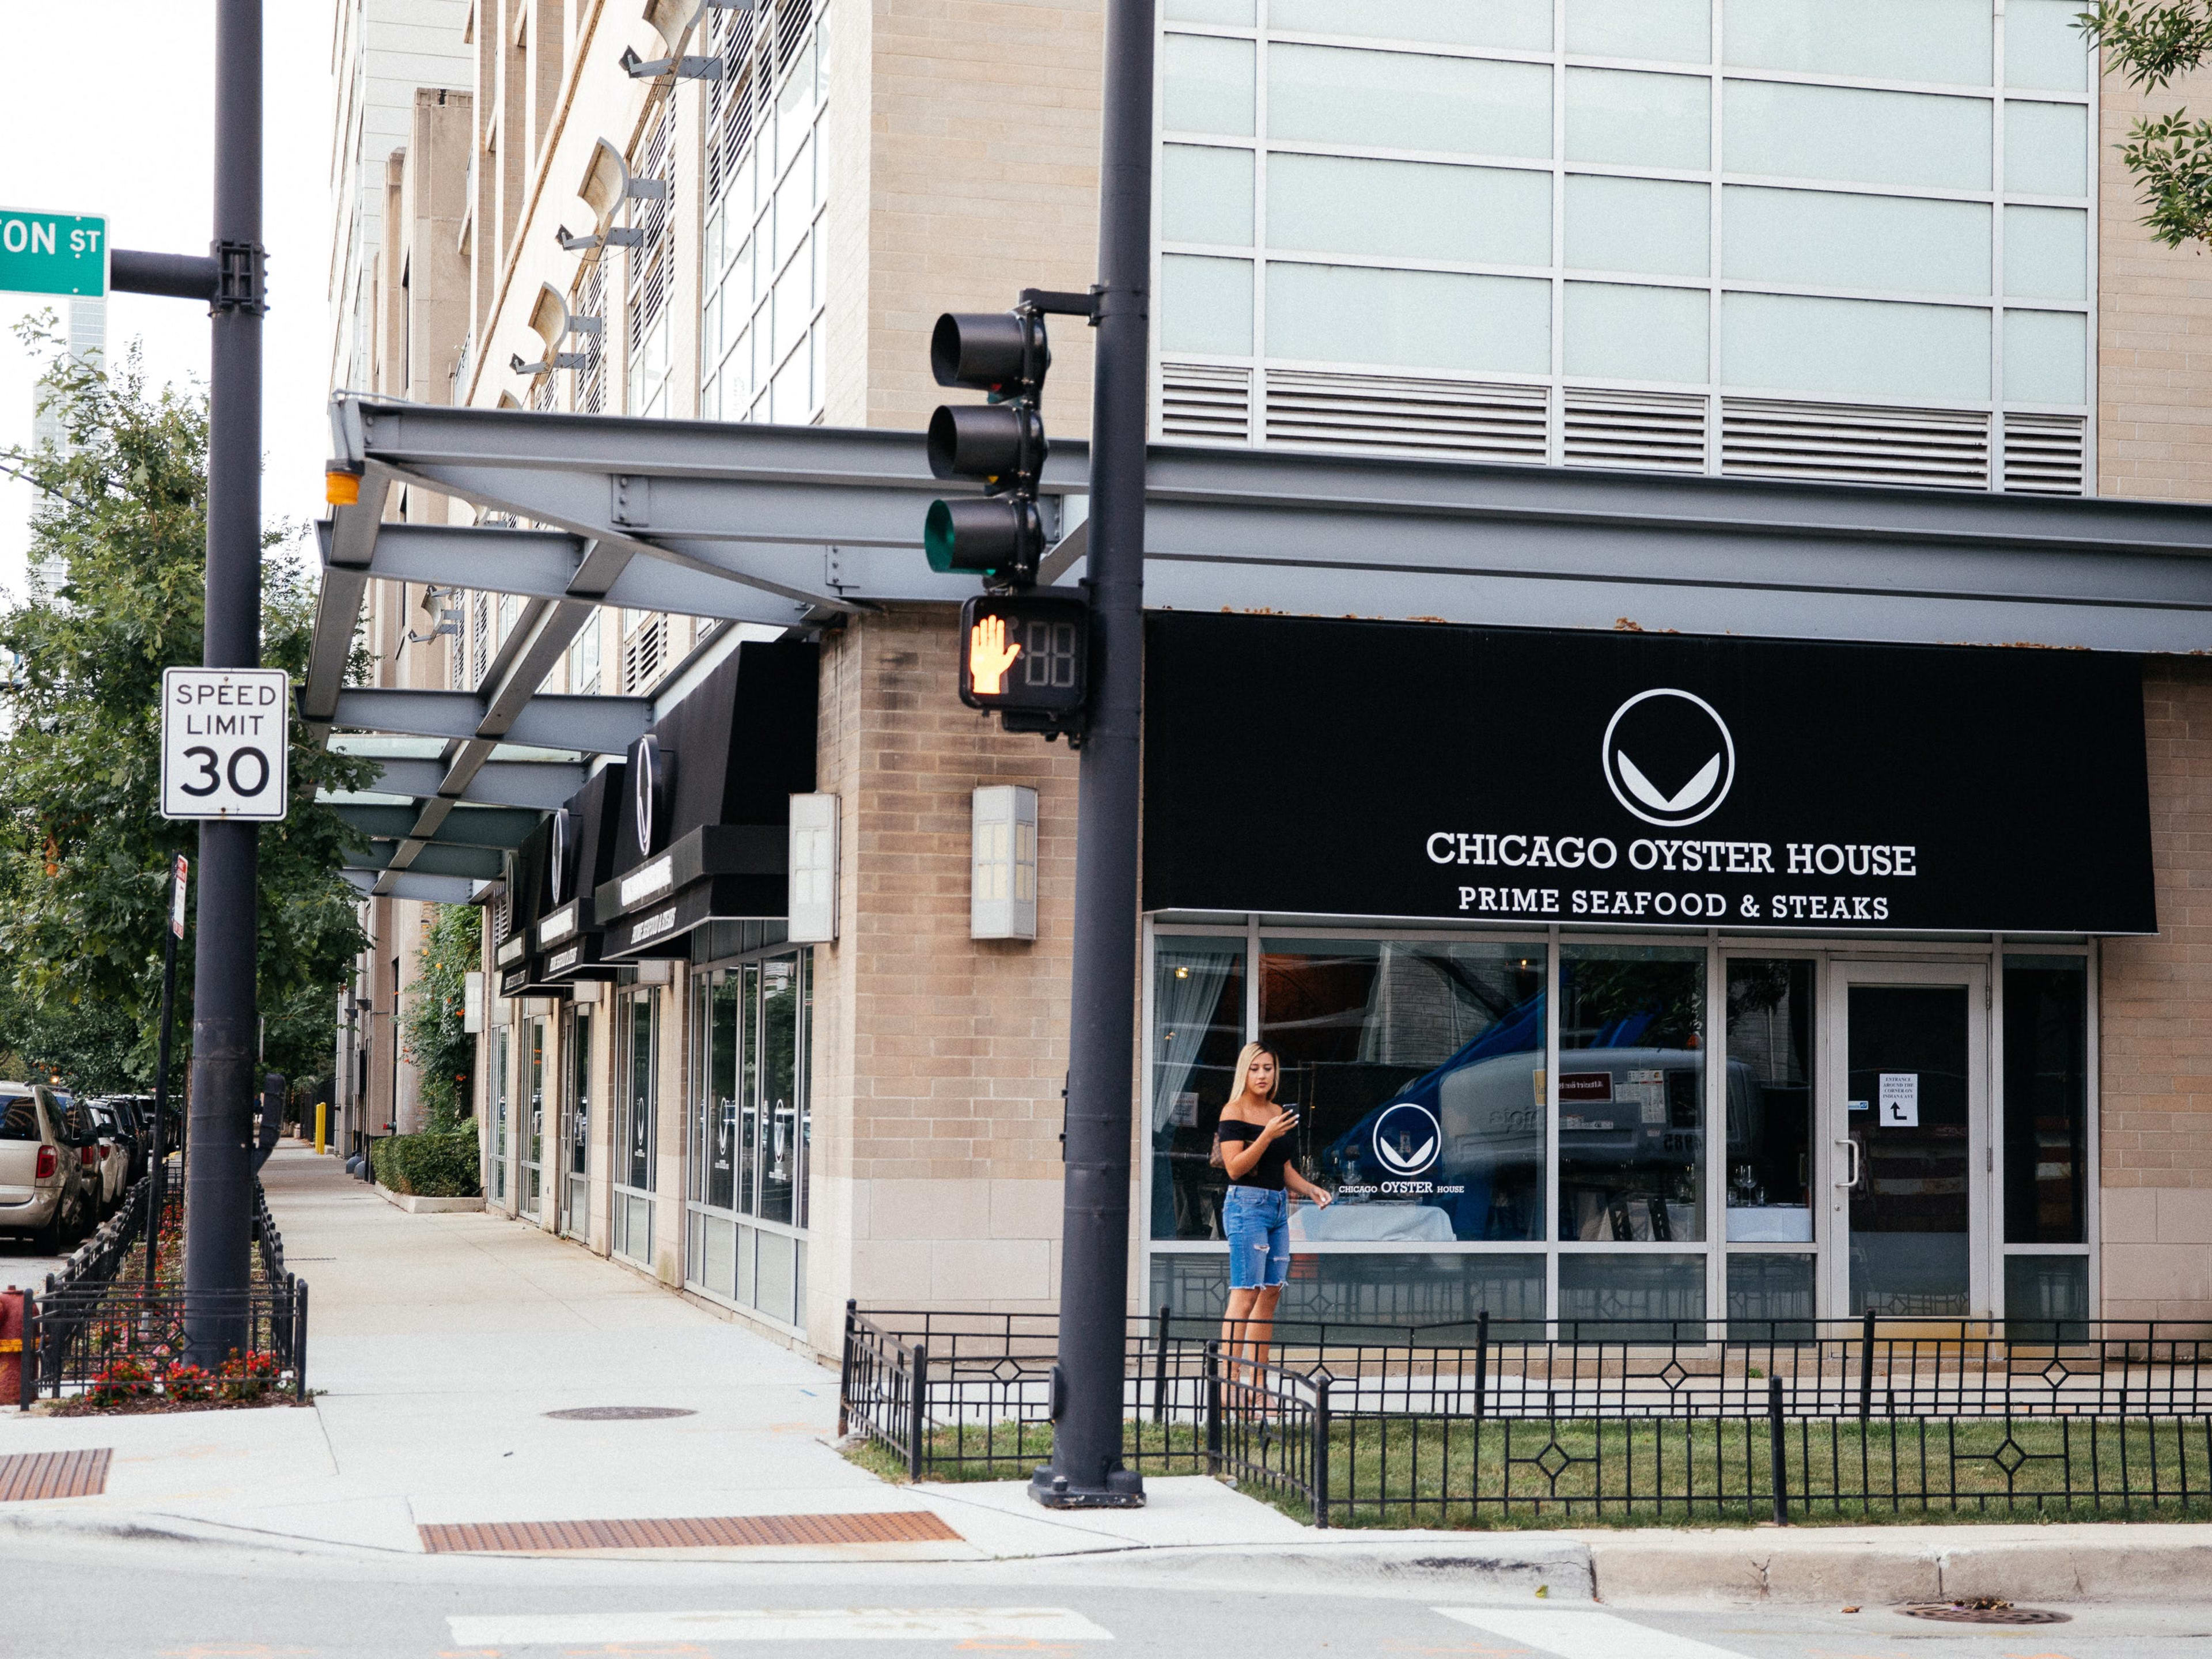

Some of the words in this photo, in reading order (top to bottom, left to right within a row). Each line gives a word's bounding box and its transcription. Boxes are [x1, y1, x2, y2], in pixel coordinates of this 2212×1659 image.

[0, 219, 56, 255] ON
[70, 229, 101, 252] ST
[176, 684, 276, 706] SPEED
[187, 714, 264, 736] LIMIT
[180, 745, 270, 798] 30
[1426, 832, 1618, 869] CHICAGO
[1628, 839, 1775, 873] OYSTER
[1786, 843, 1916, 876] HOUSE
[1459, 886, 1559, 912] PRIME
[1571, 889, 1727, 917] SEAFOOD
[1740, 894, 1760, 918] &
[1772, 895, 1889, 920] STEAKS
[1338, 1185, 1378, 1194] CHICAGO
[1381, 1181, 1433, 1194] OYSTER
[1437, 1185, 1465, 1194] HOUSE
